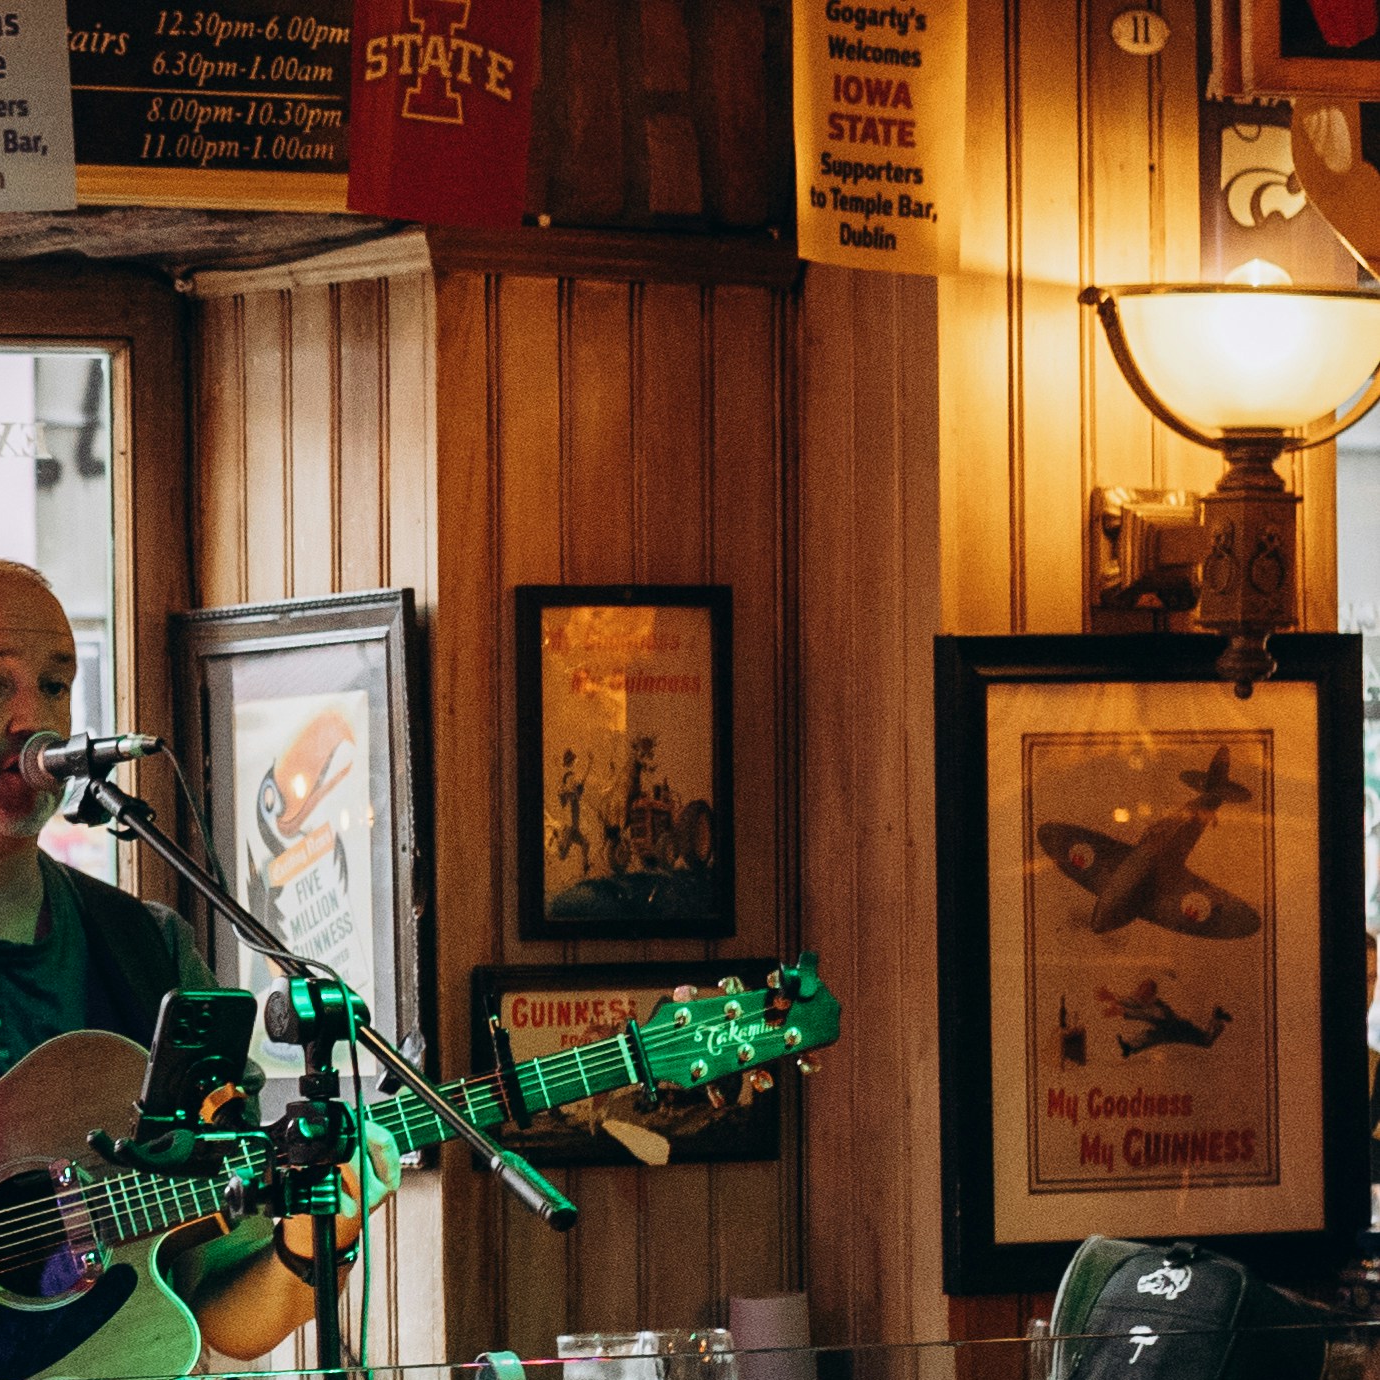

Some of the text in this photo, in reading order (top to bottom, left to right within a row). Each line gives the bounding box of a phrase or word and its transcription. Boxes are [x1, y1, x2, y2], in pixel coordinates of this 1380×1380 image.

[153, 10, 351, 47] 12.30pm-6.00pm
[826, 0, 928, 34] Gogarty's
[1132, 16, 1150, 44] 11
[152, 50, 334, 88] 6.30pm-1.00am
[364, 33, 514, 101] STATE
[828, 34, 922, 68] Welcomes
[833, 73, 914, 110] IOWA
[146, 98, 343, 132] 8.00pm-10.30pm
[828, 112, 916, 149] STATE
[3, 131, 49, 158] Bar,
[140, 132, 335, 168] 11.00pm-1.00am
[820, 152, 924, 186] Supporters
[810, 185, 938, 223] to Temple Bar,
[839, 223, 898, 252] Dublin
[294, 867, 324, 905] FIVE
[289, 887, 341, 942] MILLION
[1047, 1085, 1194, 1127] My Goodness
[1079, 1127, 1257, 1174] My GUINNESS
